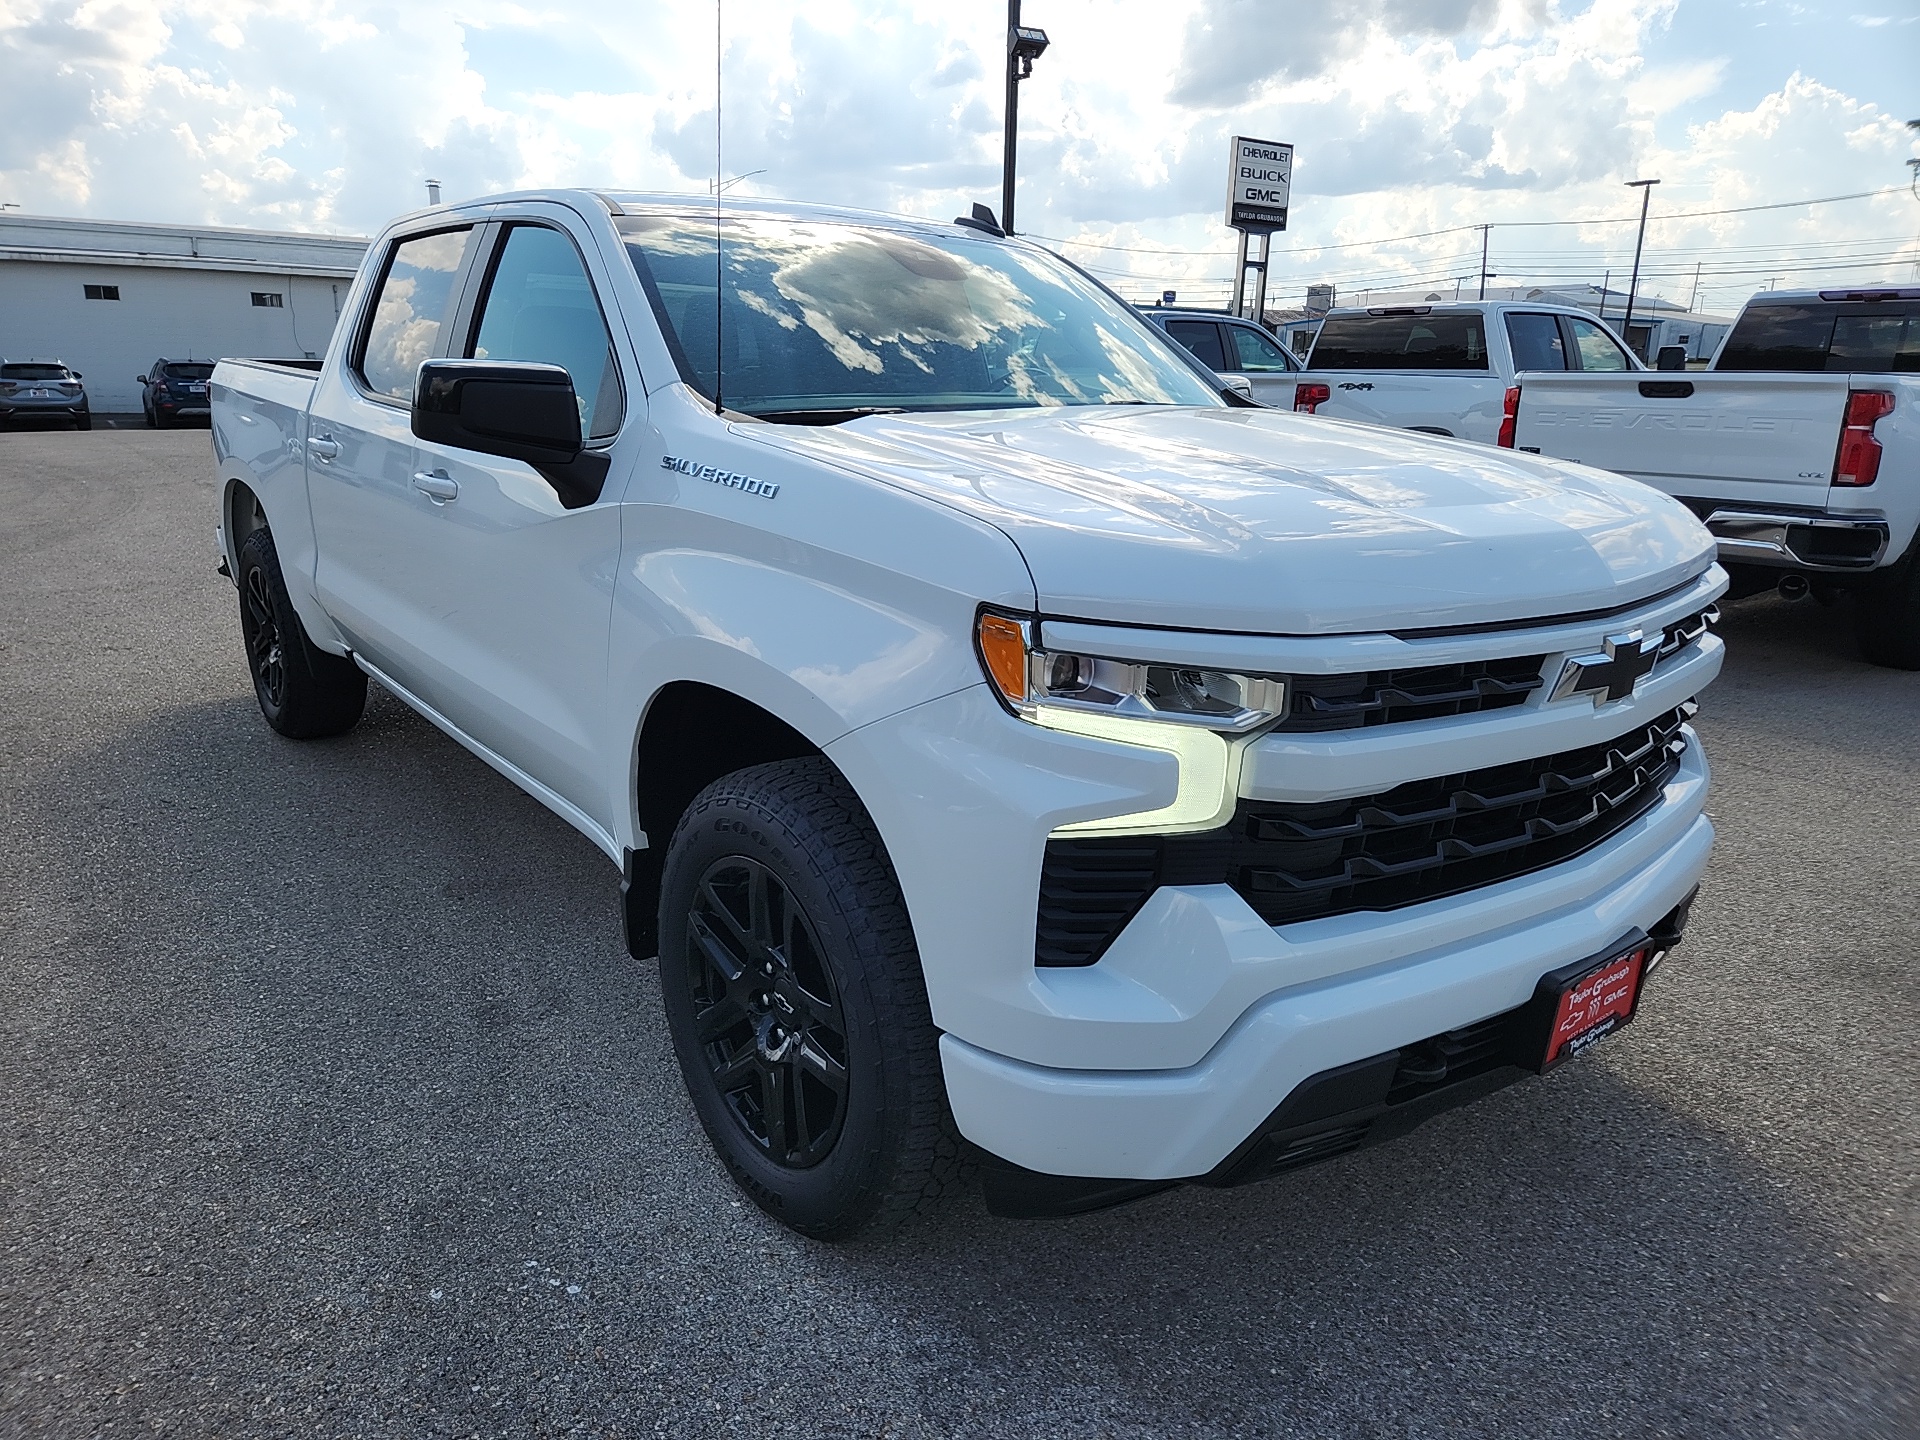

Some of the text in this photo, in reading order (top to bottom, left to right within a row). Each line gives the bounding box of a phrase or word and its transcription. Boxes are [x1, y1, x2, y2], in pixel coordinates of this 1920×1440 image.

[1243, 147, 1289, 162] CHEVROLET
[1241, 167, 1287, 183] BUICK
[1245, 188, 1280, 203] GMC
[1534, 410, 1814, 435] CHEVROLET
[660, 454, 780, 499] SILVERADO
[1568, 965, 1630, 1010] Taylor Grubaugh
[1603, 986, 1628, 1006] GMC
